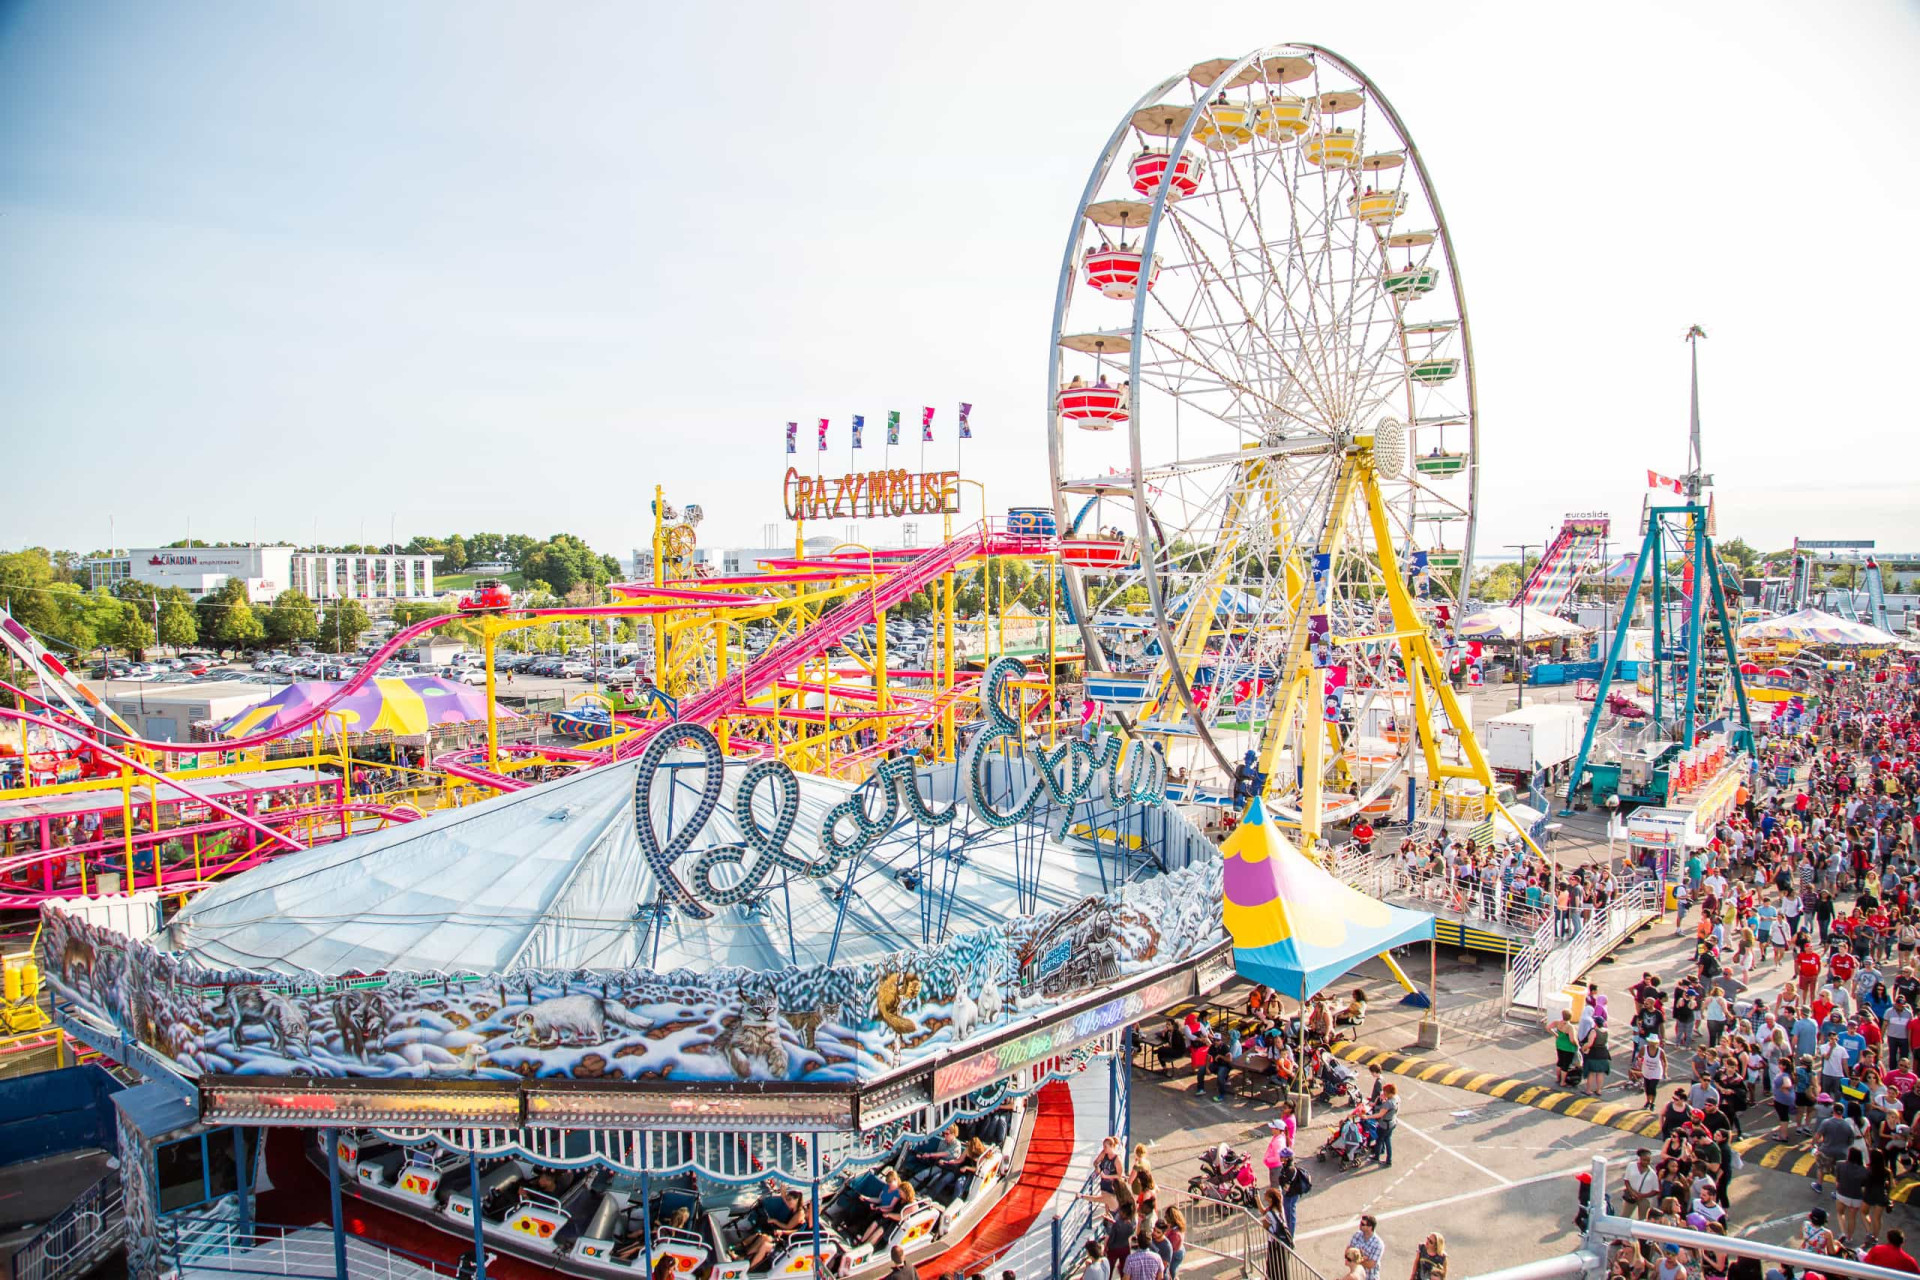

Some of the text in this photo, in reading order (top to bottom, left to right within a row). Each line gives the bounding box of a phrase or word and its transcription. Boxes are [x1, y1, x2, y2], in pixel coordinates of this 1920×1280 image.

[784, 467, 960, 520] CRAZY MOUSE
[1565, 510, 1609, 519] euroslide
[161, 556, 198, 566] CANADIAN
[632, 721, 958, 919] Polar
[1041, 950, 1071, 973] EXPRESS
[1046, 940, 1071, 960] POLAR
[934, 1052, 998, 1097] Music
[1054, 1023, 1075, 1047] the
[1075, 999, 1124, 1036] World
